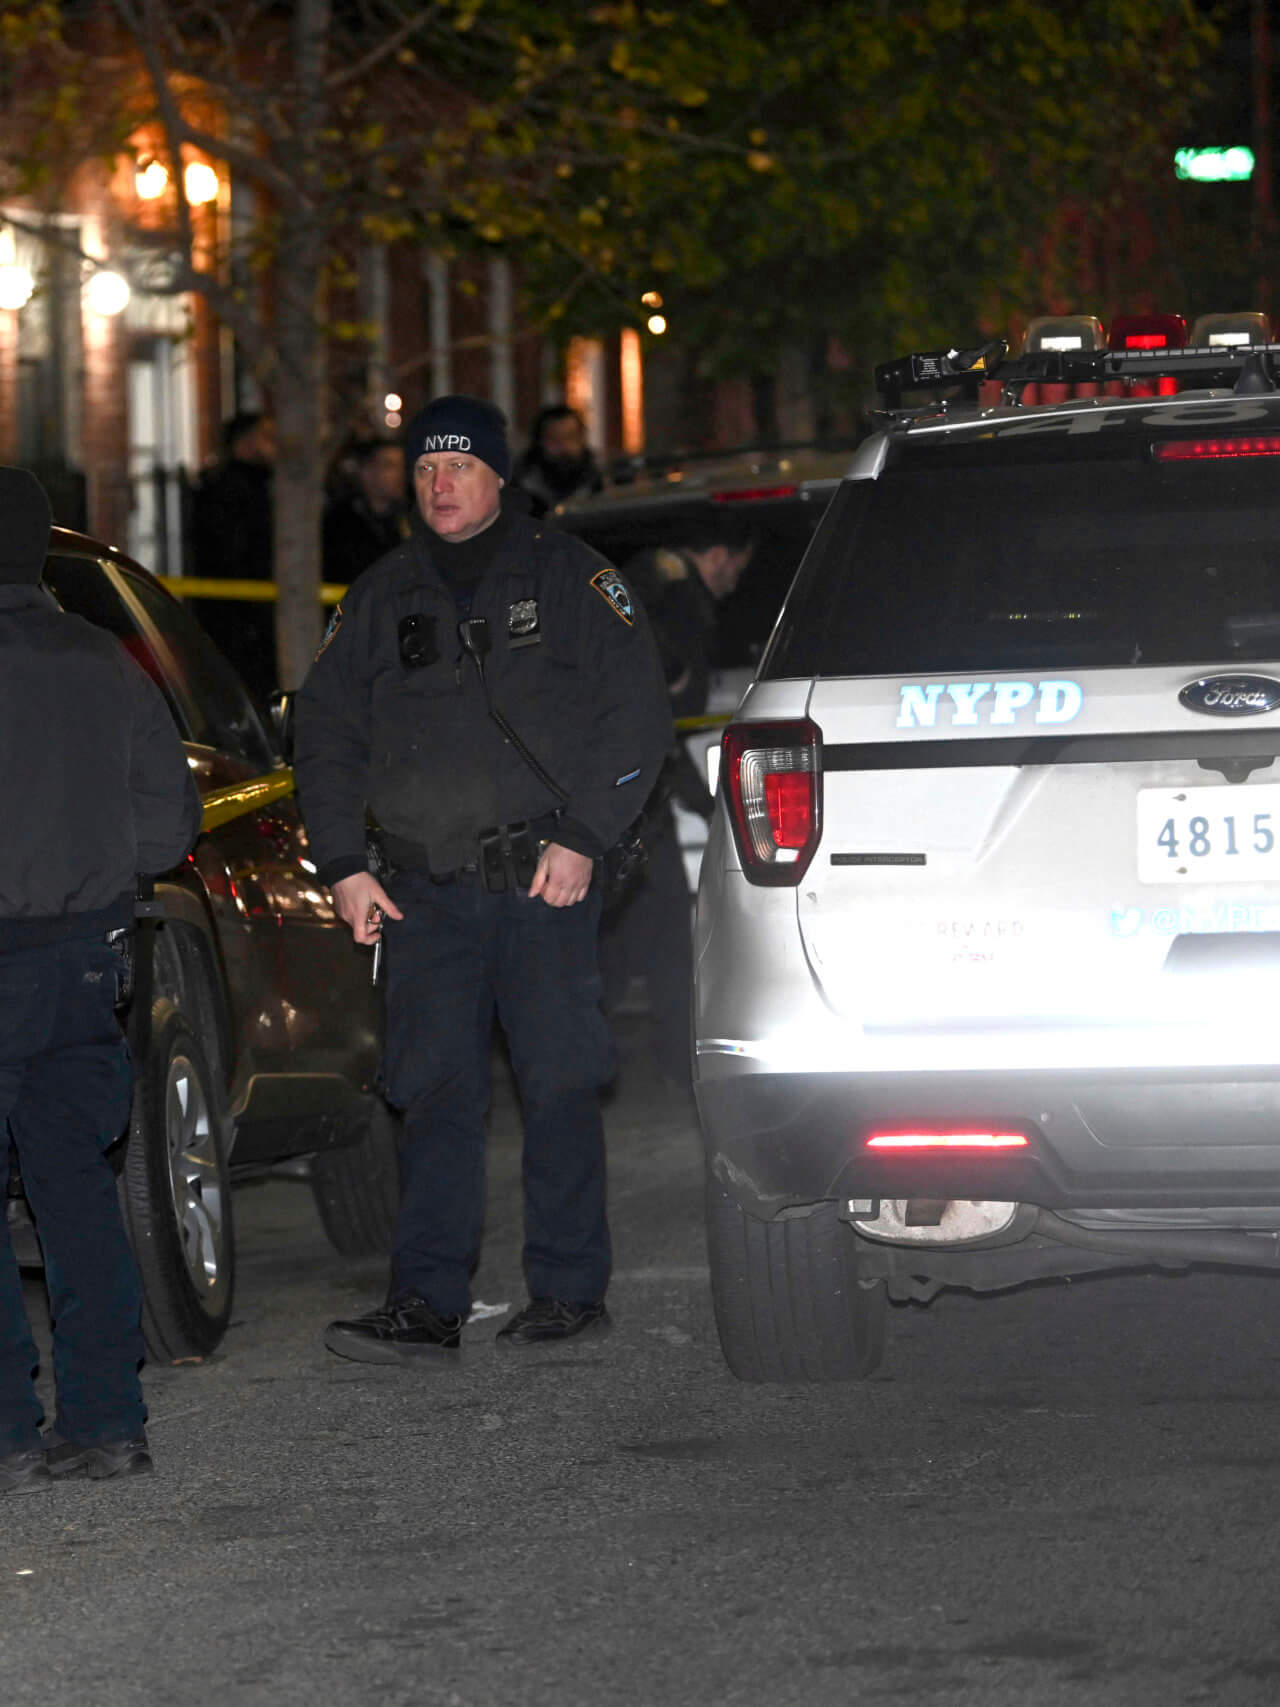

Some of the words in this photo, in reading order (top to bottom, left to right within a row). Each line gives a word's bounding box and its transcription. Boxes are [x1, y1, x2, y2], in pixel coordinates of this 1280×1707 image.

[425, 434, 472, 451] NYPD
[895, 680, 1084, 728] NYPD
[1204, 688, 1267, 707] Ford
[1157, 813, 1276, 858] 4815
